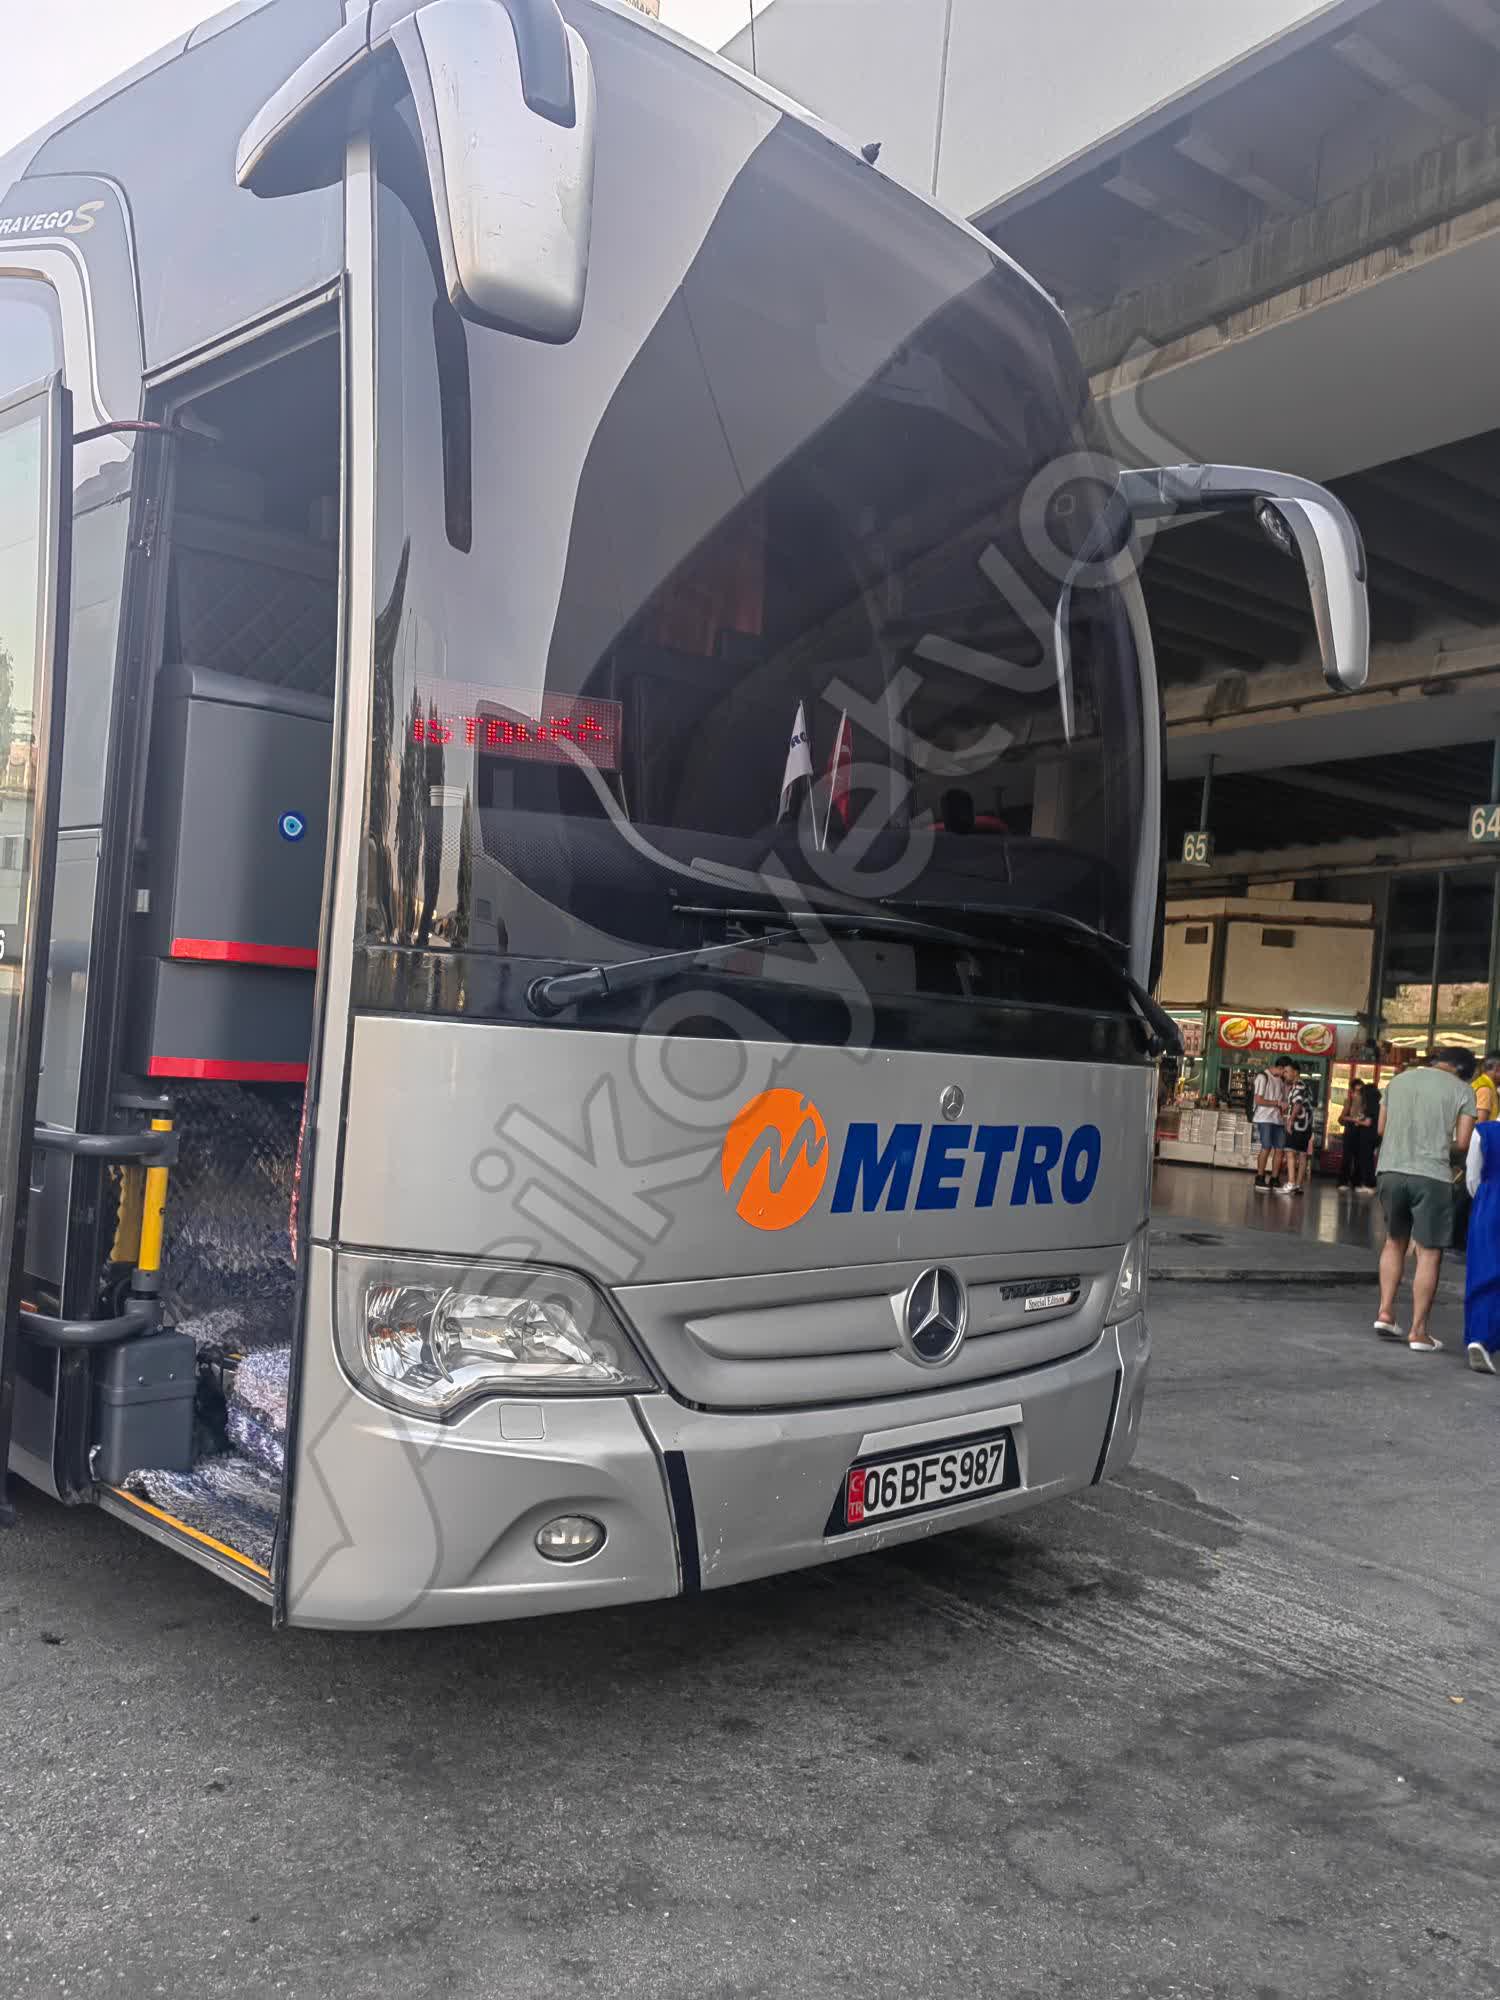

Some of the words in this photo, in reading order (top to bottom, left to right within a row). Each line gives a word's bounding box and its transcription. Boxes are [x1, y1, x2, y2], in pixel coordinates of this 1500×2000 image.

[1471, 807, 1500, 839] 64
[1184, 834, 1208, 861] 65
[1255, 1019, 1298, 1032] MEŞHUR
[1255, 1030, 1297, 1041] AYVALIK
[1258, 1040, 1292, 1051] TOSTU
[830, 1122, 1101, 1214] METRO
[864, 1443, 1004, 1512] 06BFS987
[850, 1501, 864, 1517] TR
